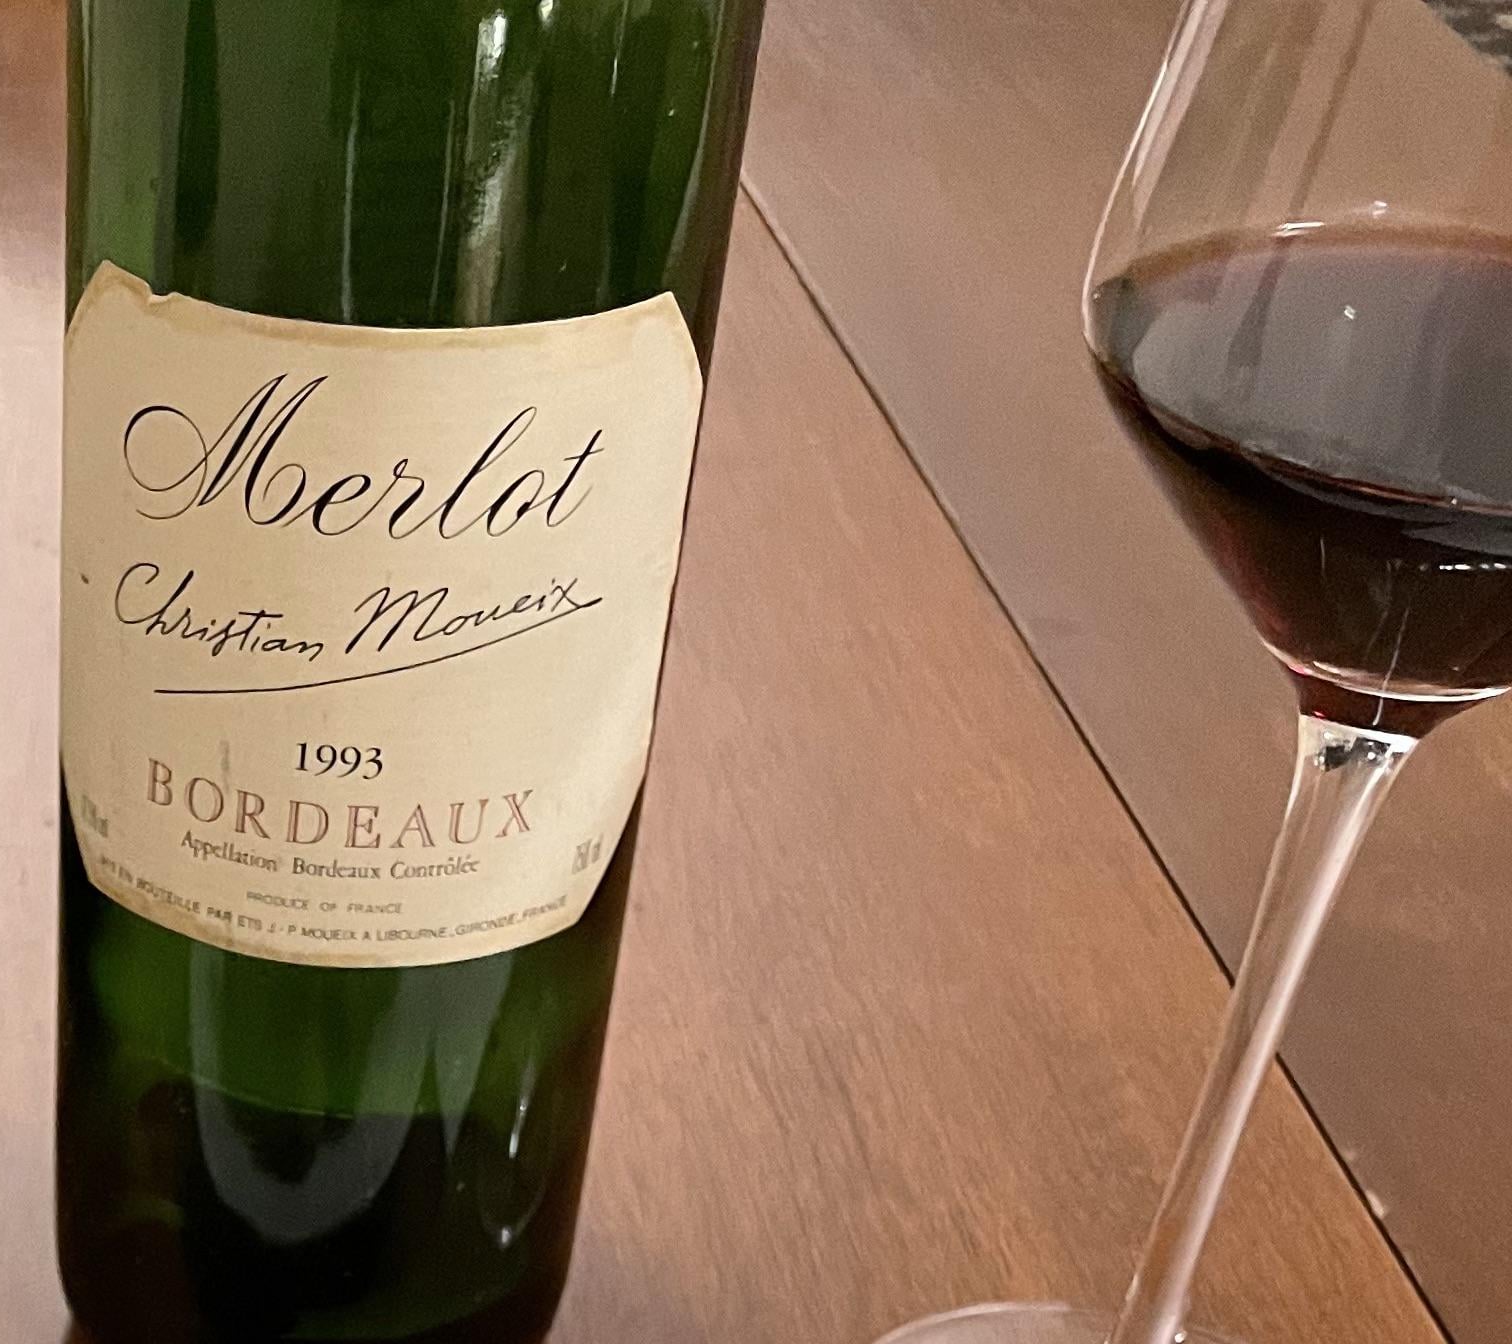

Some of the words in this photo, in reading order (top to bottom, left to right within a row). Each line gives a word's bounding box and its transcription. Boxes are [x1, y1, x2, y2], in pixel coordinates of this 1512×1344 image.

[124, 373, 605, 539] Merlot
[114, 562, 324, 661] Christian
[345, 576, 603, 656] Moueix
[295, 742, 384, 780] 1993
[146, 757, 534, 849] BORDEAUX
[181, 830, 278, 873] Appellation
[292, 857, 382, 879] Bordeaux
[390, 854, 481, 879] Contrôlée
[206, 906, 233, 923] PAR
[319, 903, 337, 912] OF
[346, 902, 403, 914] FRANCE
